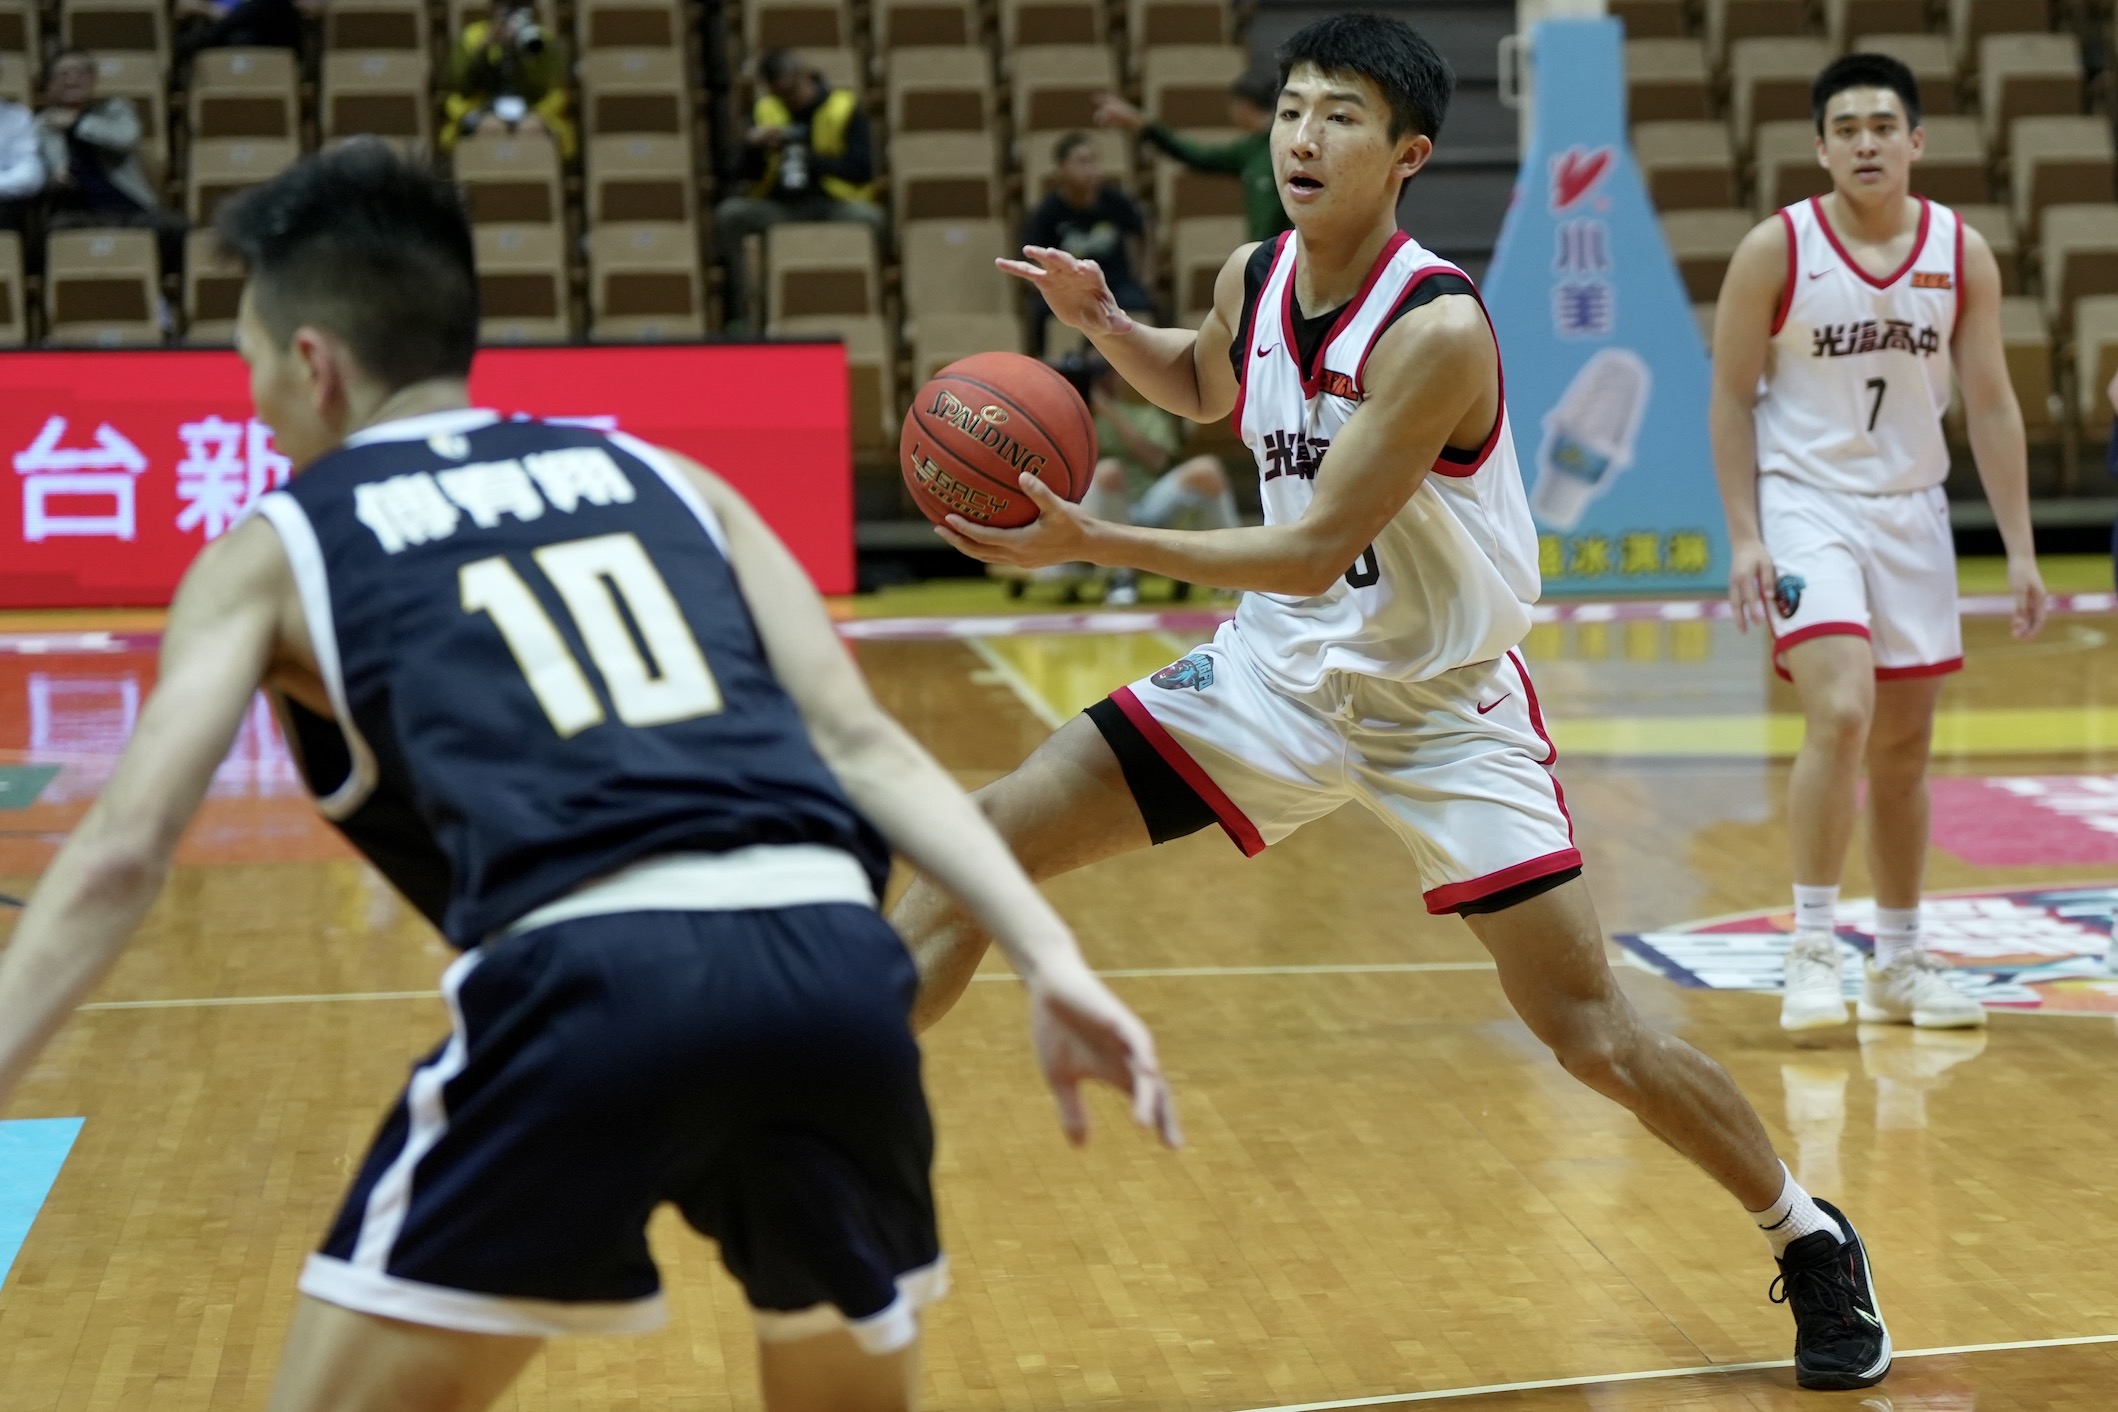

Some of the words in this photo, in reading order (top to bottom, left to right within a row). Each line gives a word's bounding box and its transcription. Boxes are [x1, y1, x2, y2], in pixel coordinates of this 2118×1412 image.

[927, 389, 1048, 477] SPALDING
[1866, 376, 1887, 432] 7
[911, 442, 1009, 513] LEGACY
[458, 532, 725, 739] 10
